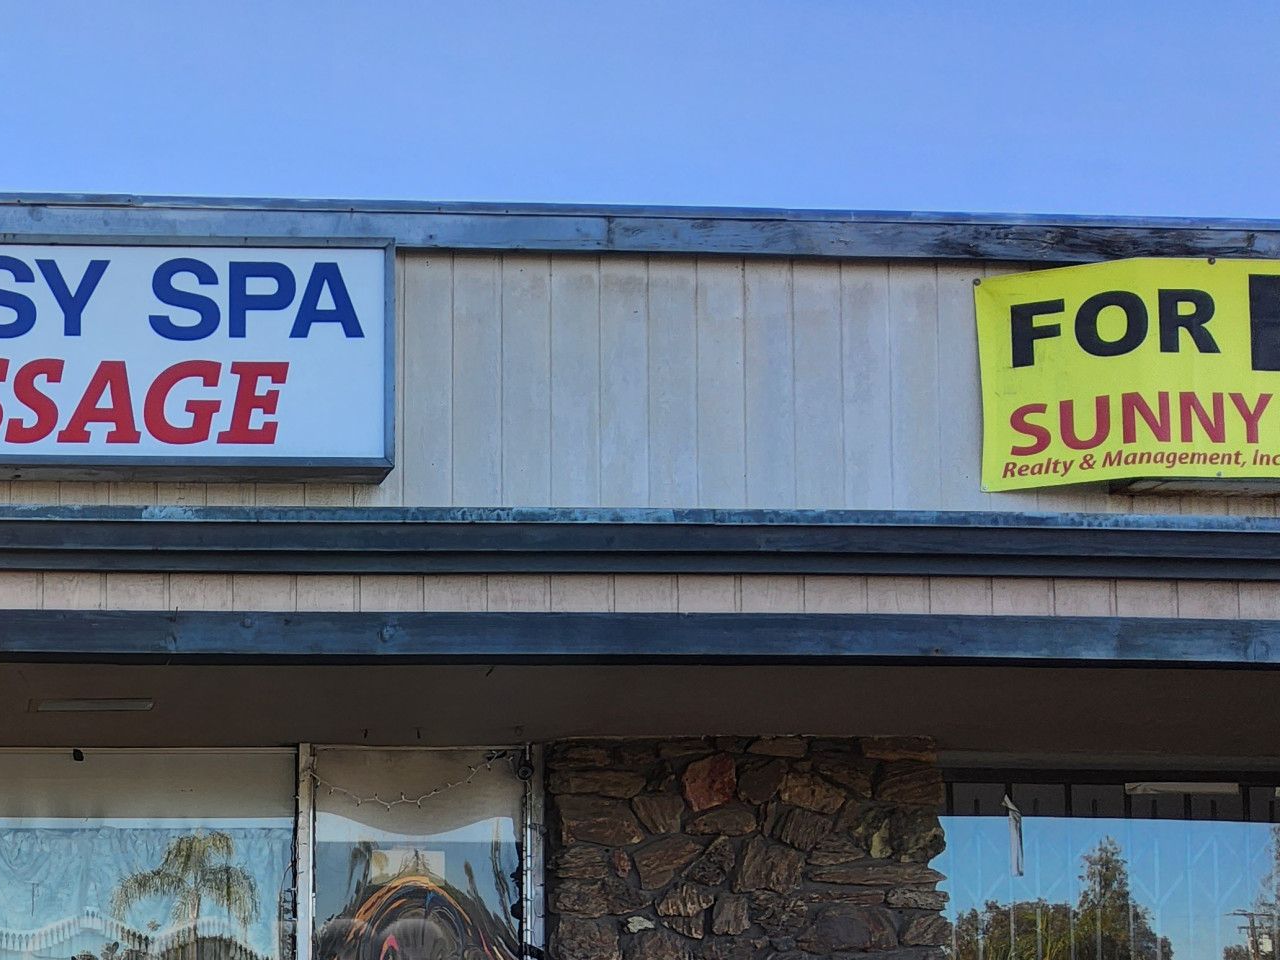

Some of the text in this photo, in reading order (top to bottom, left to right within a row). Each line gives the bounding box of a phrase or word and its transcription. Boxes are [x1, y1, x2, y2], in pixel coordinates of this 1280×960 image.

[149, 258, 364, 341] SPA
[1010, 288, 1221, 368] FOR
[1009, 391, 1273, 457] SUNNY
[1002, 457, 1075, 479] Realty
[1078, 453, 1097, 471] &
[1102, 449, 1247, 469] Management,
